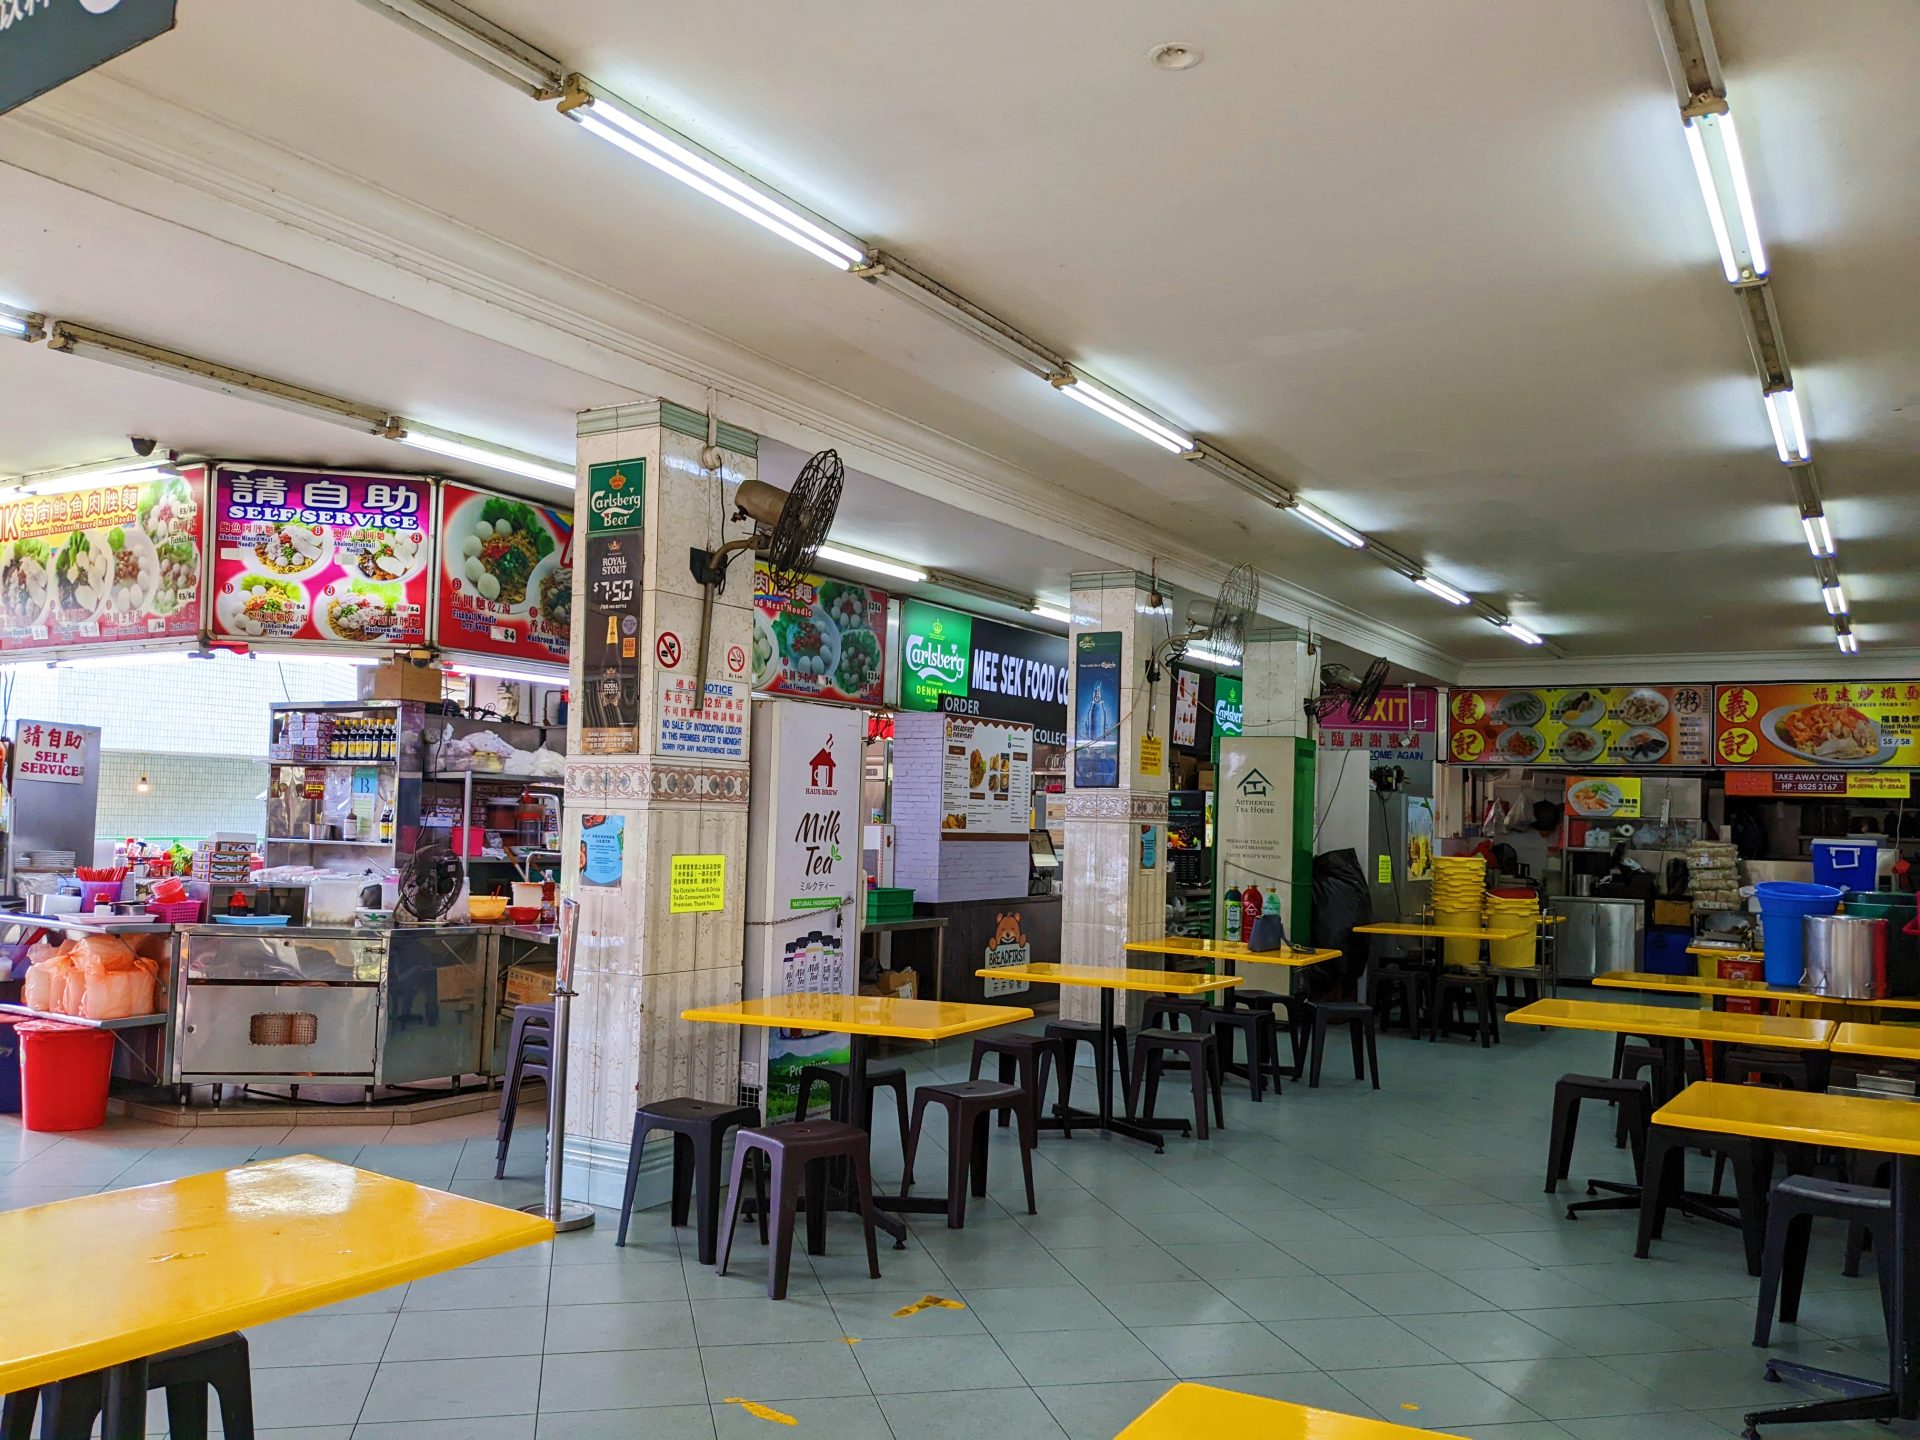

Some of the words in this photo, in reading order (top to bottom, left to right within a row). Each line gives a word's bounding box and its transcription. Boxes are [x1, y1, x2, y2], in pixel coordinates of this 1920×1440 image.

[231, 475, 418, 513] 請自助
[591, 488, 641, 513] Carlsberg
[50, 523, 75, 535] Abalone
[75, 520, 97, 531] Minced
[97, 517, 113, 528] Meat
[114, 513, 137, 525] Noodle
[229, 506, 295, 521] SELF
[300, 510, 418, 529] SERVICE
[603, 512, 630, 527] Beer
[219, 533, 240, 541] Abalone
[346, 547, 364, 555] Noodle
[355, 541, 376, 549] Fishball
[602, 556, 627, 567] ROYAL
[601, 565, 627, 576] STOUT
[766, 601, 787, 611] Meat
[787, 605, 812, 617] Noodle
[452, 609, 476, 621] Fishball
[476, 613, 497, 624] Noodle
[504, 628, 515, 641] $4
[527, 634, 554, 645] Mushroom
[548, 645, 566, 655] Noodle
[906, 634, 965, 683] Carlsberg
[972, 649, 1000, 693] MEE
[1000, 654, 1024, 698] SEK
[1024, 660, 1056, 703] FOOD
[944, 696, 980, 715] ORDER
[1216, 700, 1242, 732] Carlsber
[662, 720, 671, 729] NO
[672, 720, 684, 731] SALE
[686, 721, 692, 731] OF
[725, 725, 743, 735] LIQUOR
[23, 725, 83, 749] 請自助
[668, 732, 678, 740] THIS
[679, 733, 701, 743] PREMISES
[702, 735, 716, 744] AFTER
[717, 737, 722, 745] 12
[723, 737, 742, 746] MIDNIGHT
[662, 743, 676, 751] SORRY
[726, 747, 742, 756] CAUSED
[1396, 751, 1424, 760] AGAIN
[35, 751, 68, 763] SELF
[20, 762, 79, 776] SERVICE
[1774, 773, 1794, 781] TAKE
[1795, 773, 1821, 781] AWAY
[1822, 773, 1845, 782] ONLY
[361, 778, 370, 793] B
[1797, 783, 1817, 791] 8525
[1818, 783, 1838, 791] 2167
[1235, 799, 1275, 807] AUTHENTIC
[1250, 806, 1274, 814] HOUSE
[795, 810, 841, 845] Milk
[805, 845, 834, 876] Tea
[800, 882, 835, 891] ミルクティー
[792, 899, 812, 907] NATURAL
[989, 949, 1026, 965] BREADFIRST
